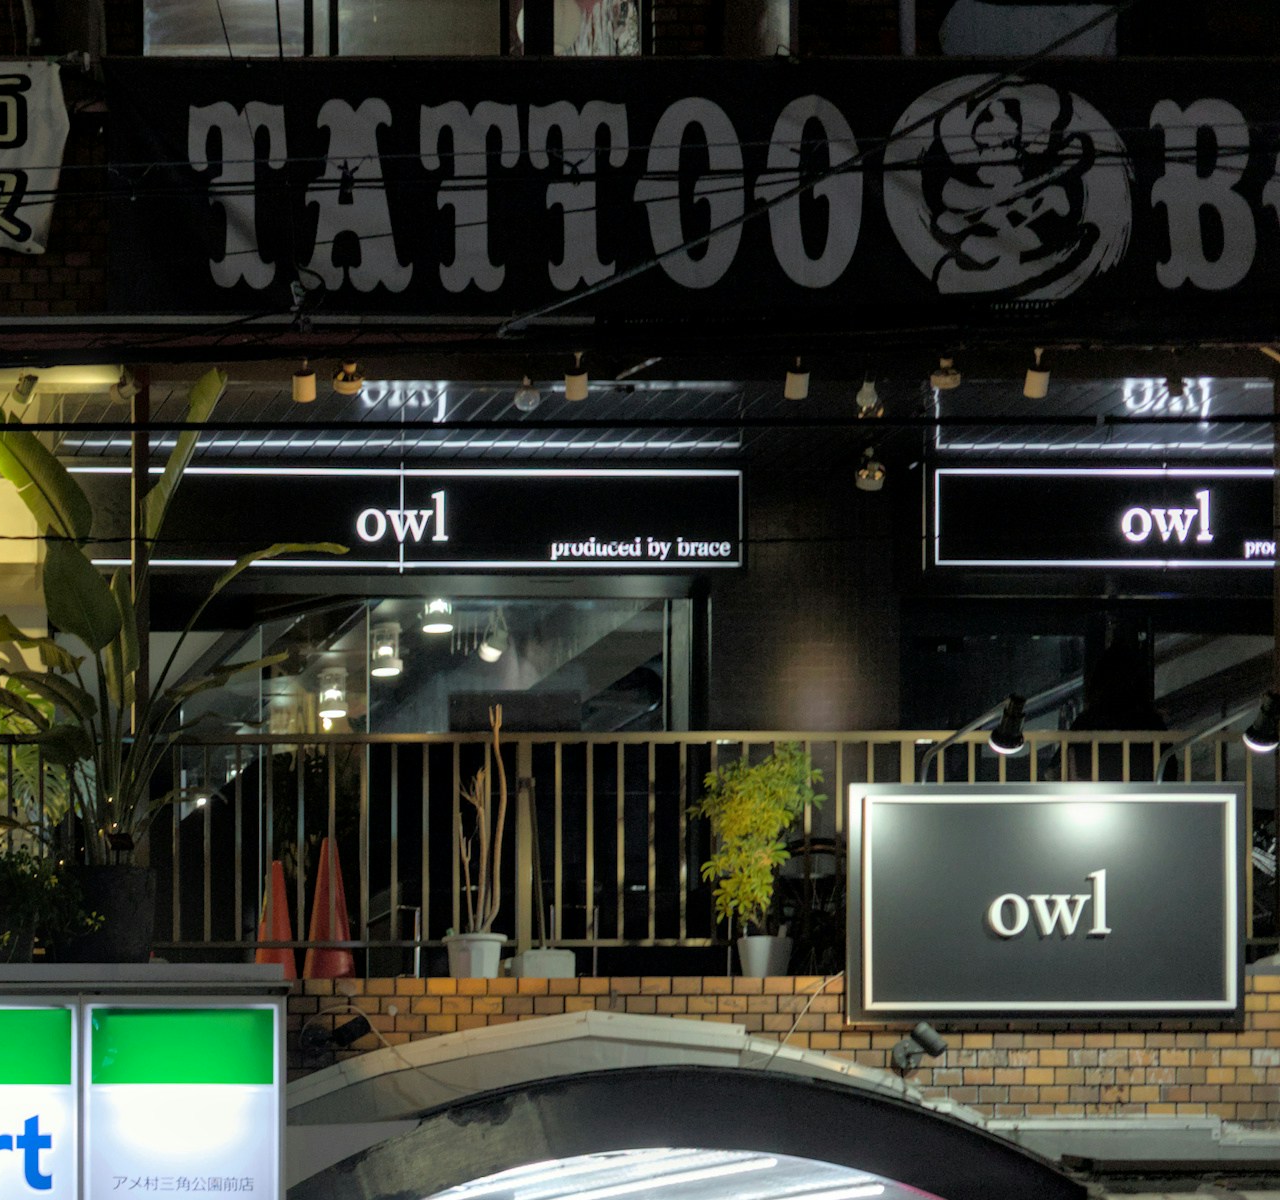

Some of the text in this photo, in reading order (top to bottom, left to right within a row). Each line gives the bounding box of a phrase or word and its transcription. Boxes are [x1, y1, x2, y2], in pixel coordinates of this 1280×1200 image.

[188, 95, 1280, 293] TATTOO B
[356, 490, 449, 543] owl
[1121, 489, 1213, 543] owl
[550, 537, 731, 560] produced by brace
[988, 868, 1112, 938] owl
[112, 1176, 255, 1193] アメ村三角公園前店
